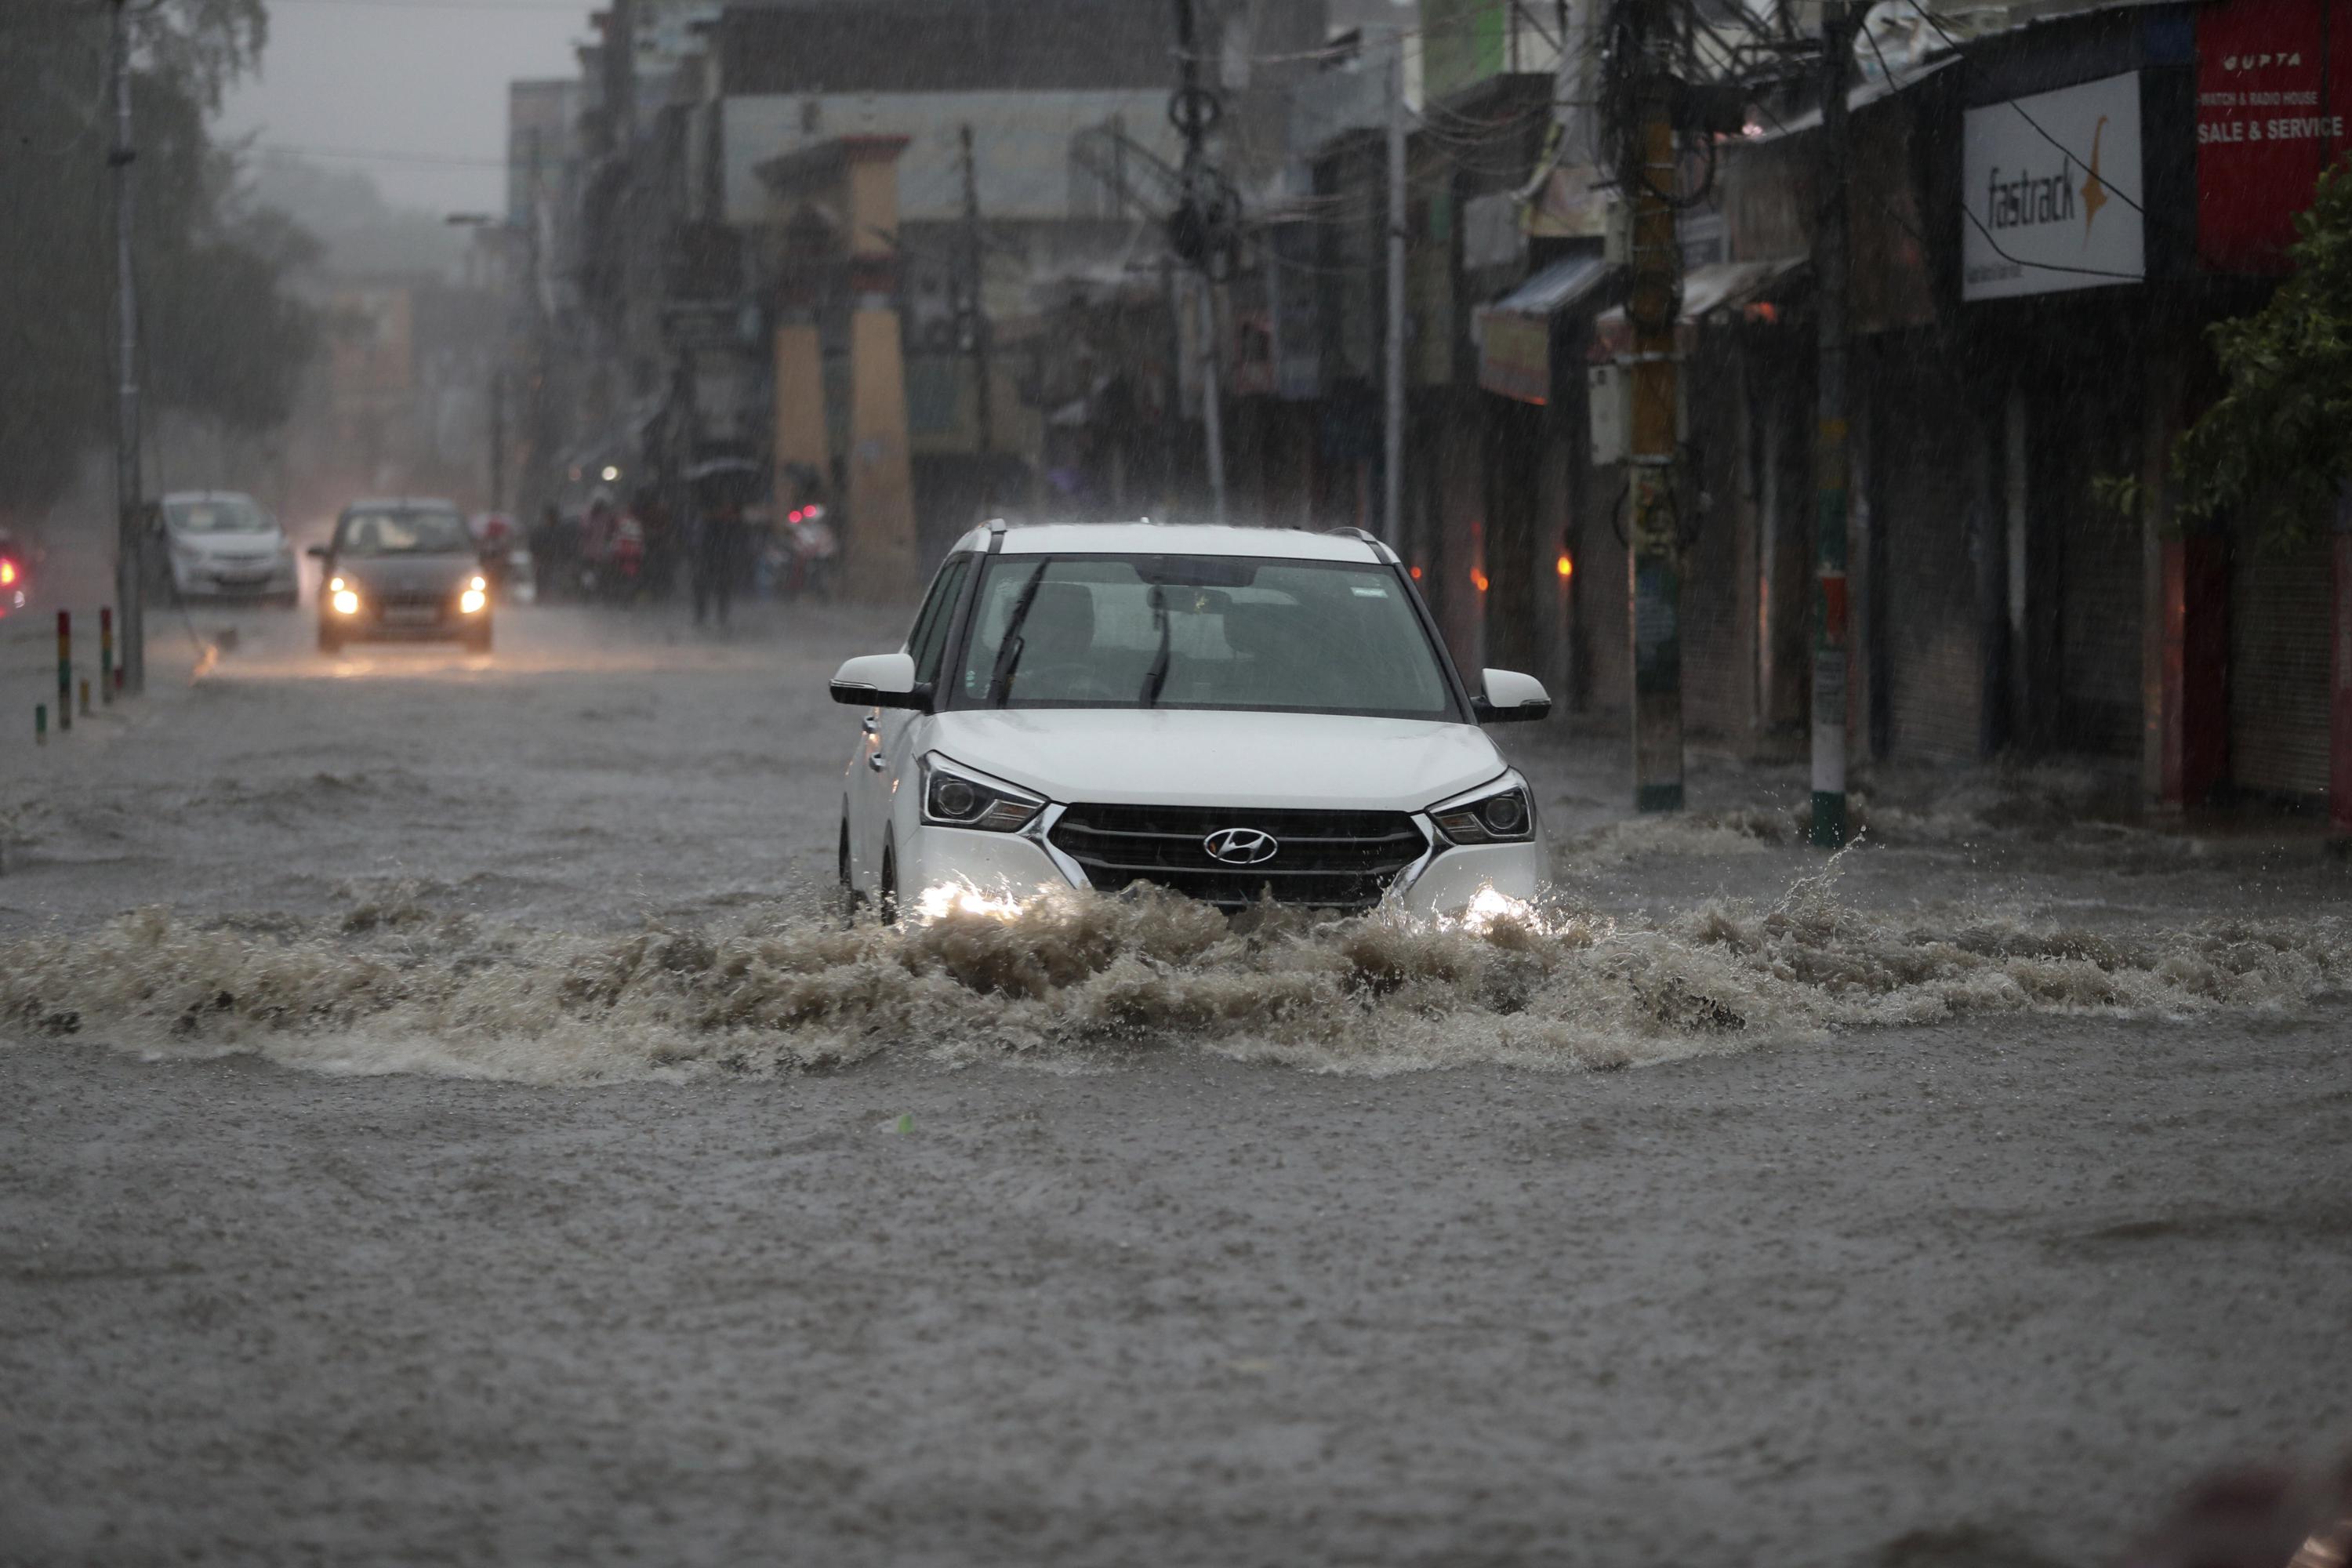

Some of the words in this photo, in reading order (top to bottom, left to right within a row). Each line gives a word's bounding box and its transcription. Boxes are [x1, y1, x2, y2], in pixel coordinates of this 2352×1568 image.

[2223, 51, 2302, 71] GUPTA
[2238, 92, 2247, 106] &
[2249, 91, 2281, 106] RADIO
[2283, 91, 2318, 105] HOUSE
[2197, 122, 2244, 143] SALE
[2249, 120, 2262, 141] &
[2267, 116, 2344, 140] SERVICE
[1987, 154, 2075, 229] fastrack
